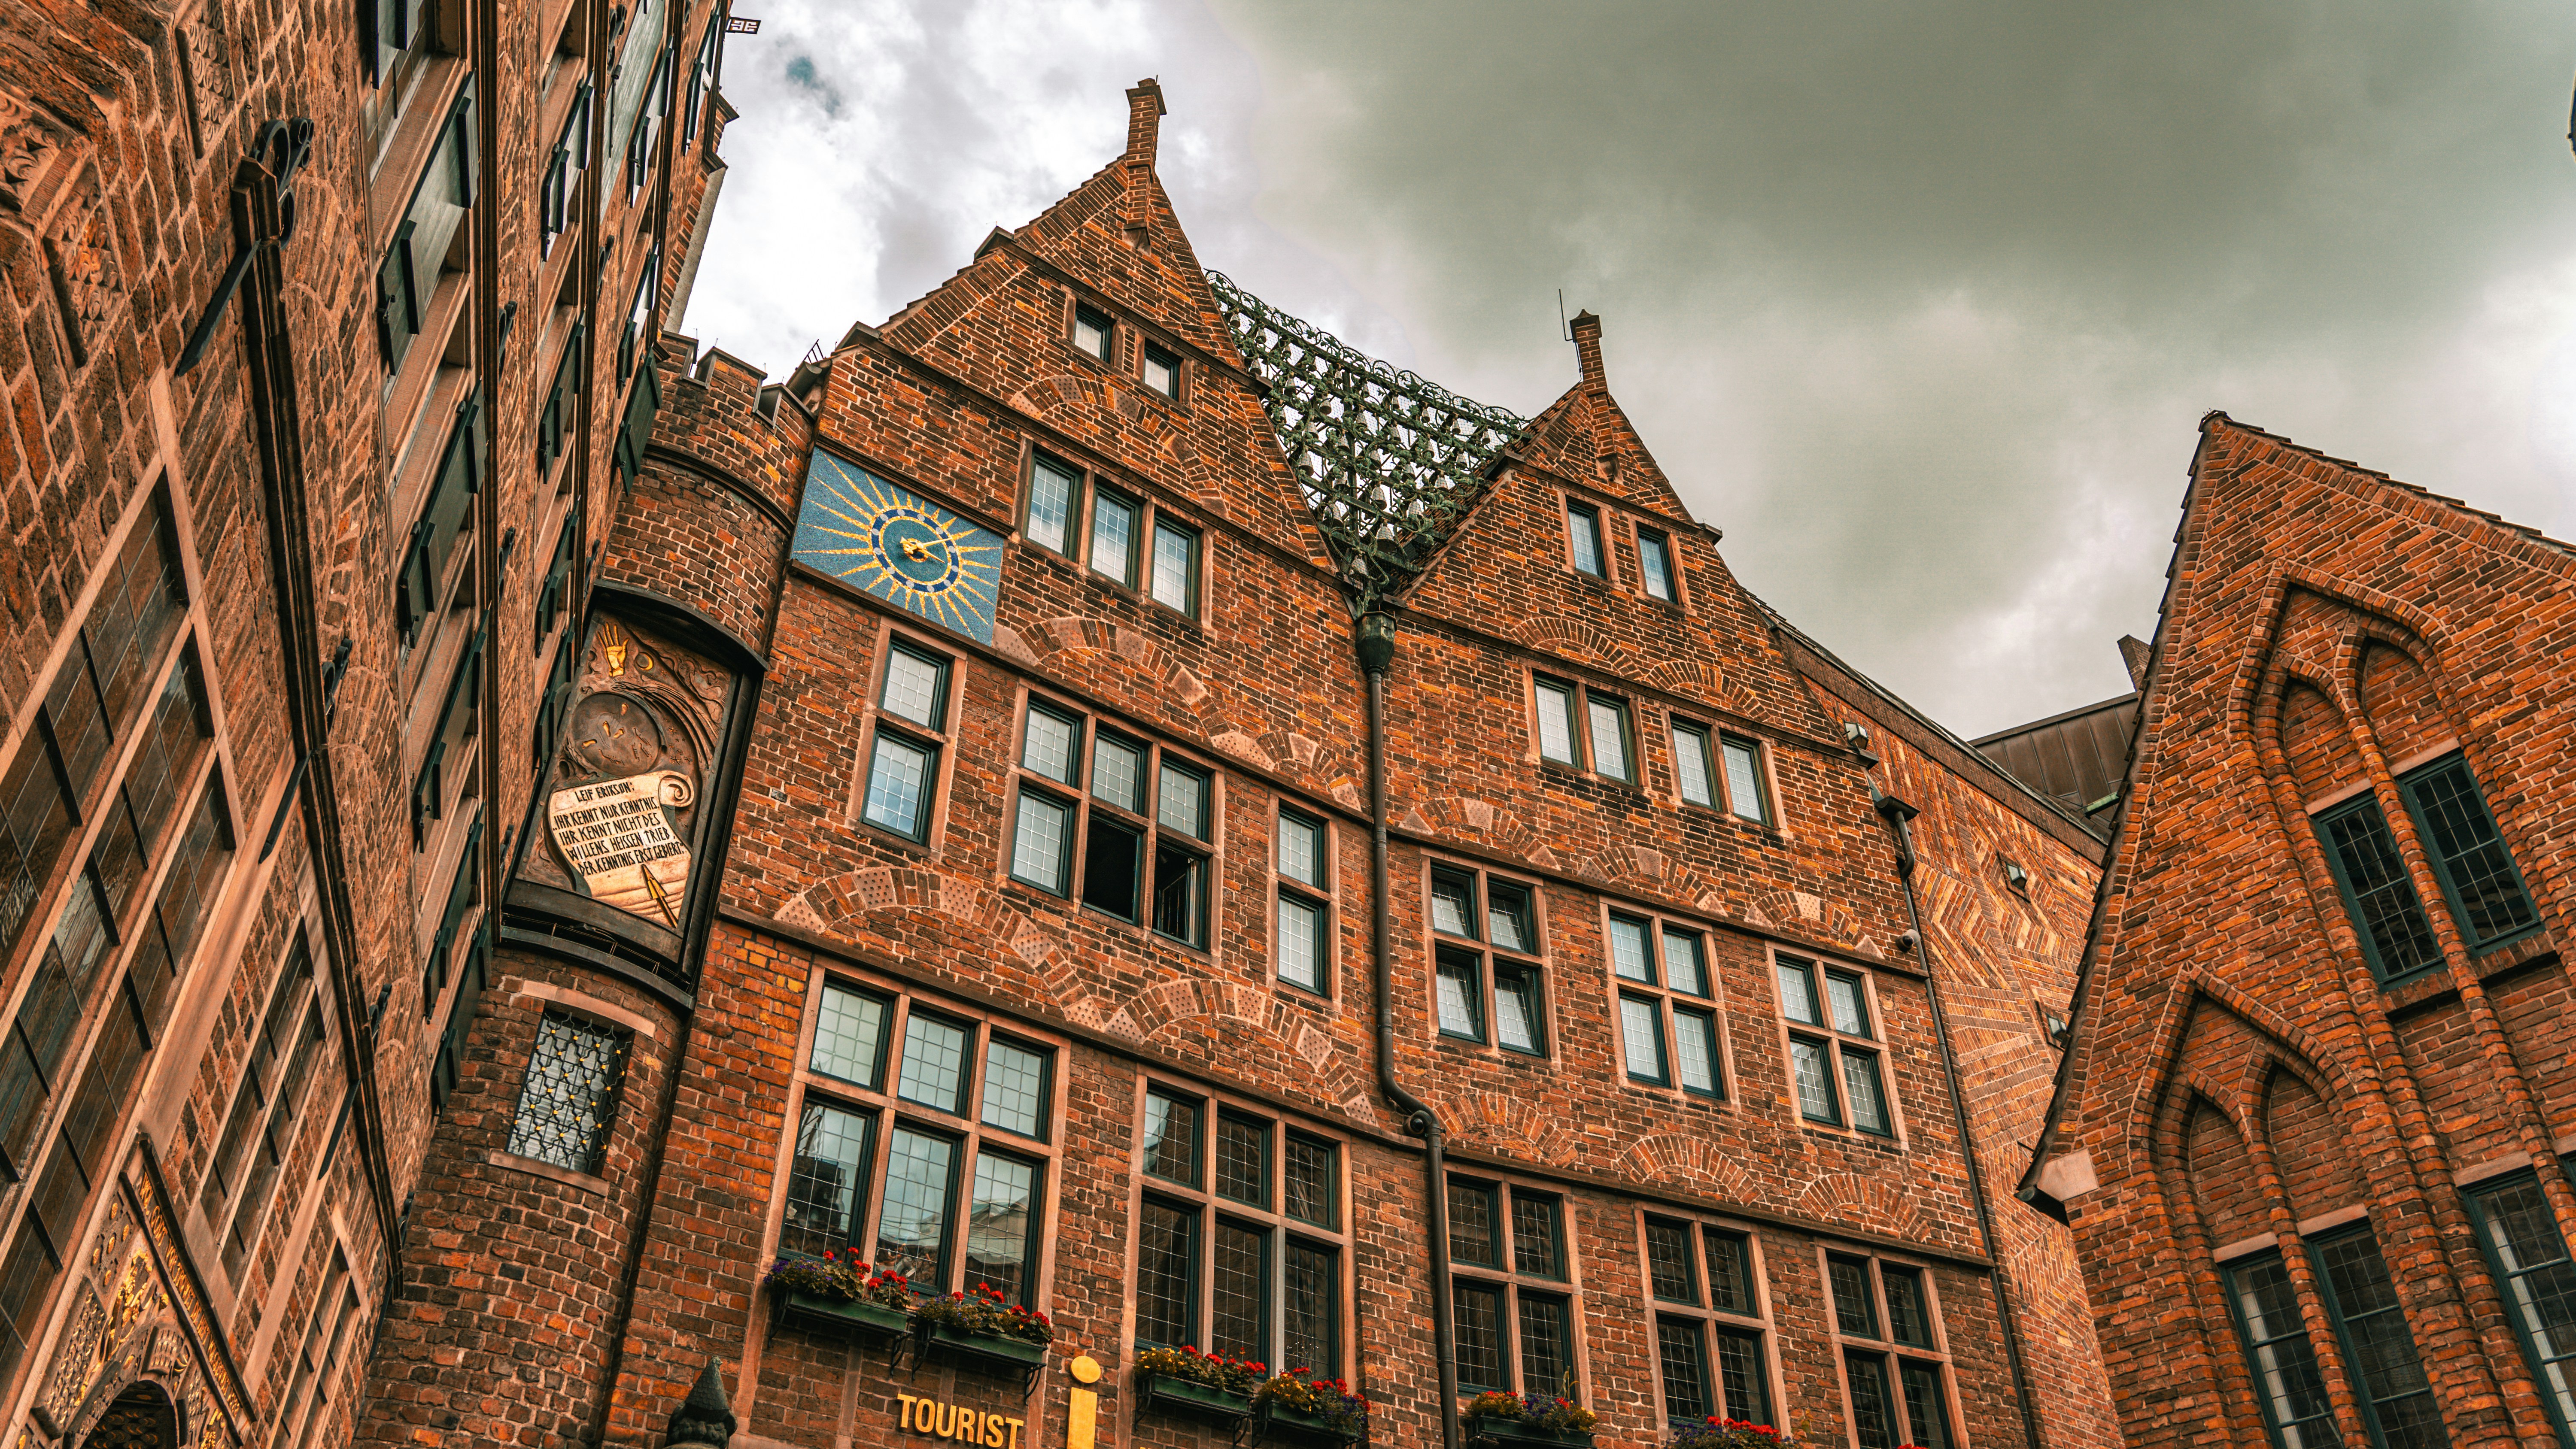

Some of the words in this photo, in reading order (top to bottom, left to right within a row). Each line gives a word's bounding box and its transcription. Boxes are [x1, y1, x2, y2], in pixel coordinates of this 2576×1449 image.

[574, 789, 593, 802] LEIF
[595, 782, 635, 798] ERIKSON:
[559, 830, 580, 846] IHR
[578, 822, 612, 841] KENNT
[613, 816, 642, 834] NICHT
[641, 813, 660, 827] DES
[570, 808, 599, 826] KENNT
[599, 804, 620, 820] NUR
[565, 840, 610, 861] WILLENS
[609, 832, 644, 852] HEISSEN
[577, 861, 598, 876] DER
[595, 852, 635, 873] KENNTNIS
[634, 847, 653, 864] ERST
[897, 1394, 1024, 1449] TOURIST
